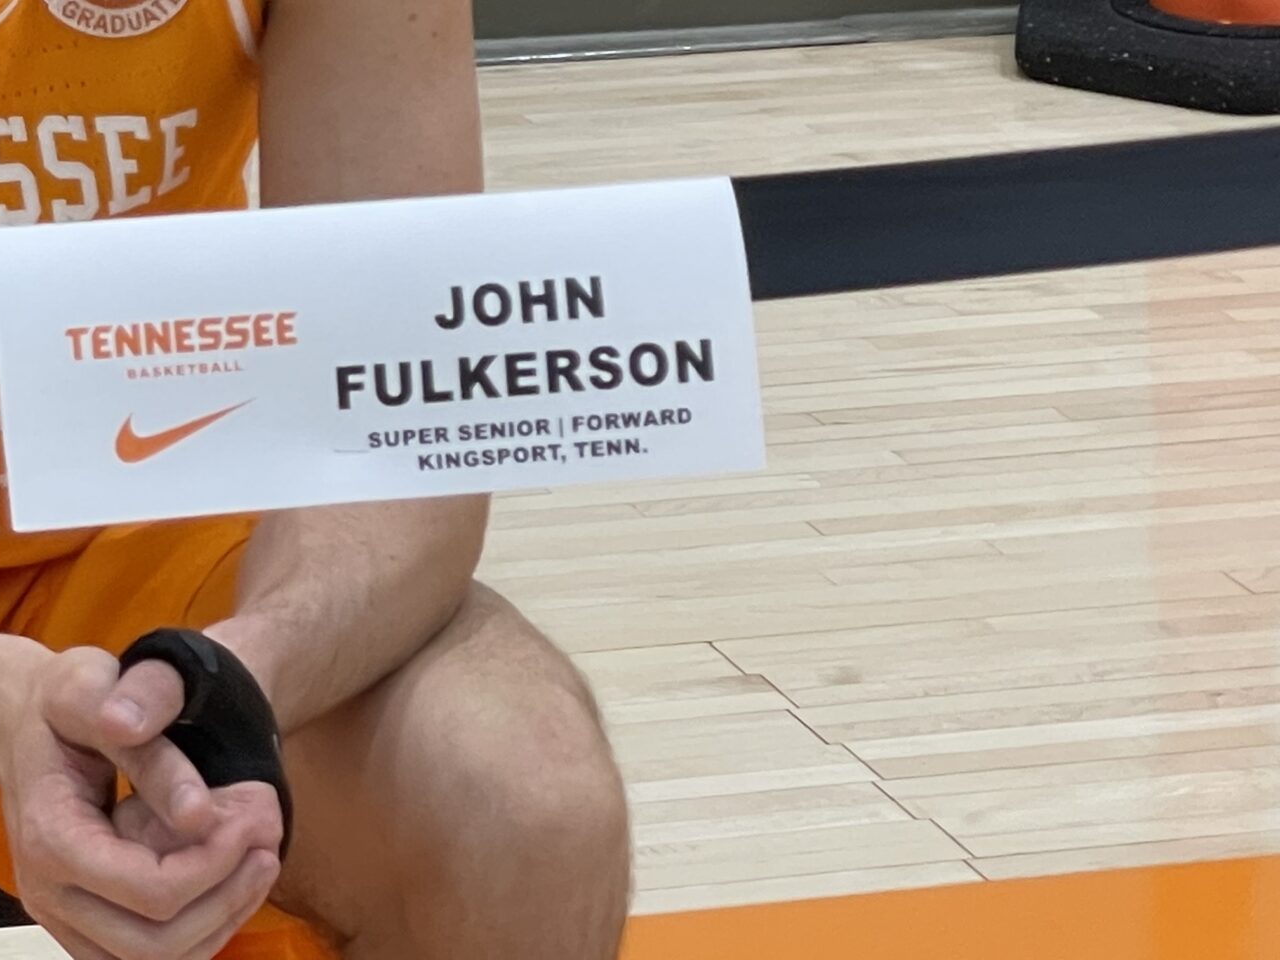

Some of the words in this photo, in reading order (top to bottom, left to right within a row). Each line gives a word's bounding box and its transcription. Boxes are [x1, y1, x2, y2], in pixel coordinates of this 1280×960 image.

[434, 275, 605, 330] JOHN
[65, 311, 299, 361] TENNESSEE
[126, 359, 245, 380] BASKETBALL
[335, 338, 715, 410] FULKERSON
[368, 426, 450, 449] SUPER
[458, 418, 552, 441] SENIOR
[572, 407, 693, 433] FORWARD
[418, 443, 568, 471] KINGSPORT,
[574, 438, 649, 459] TENN.
